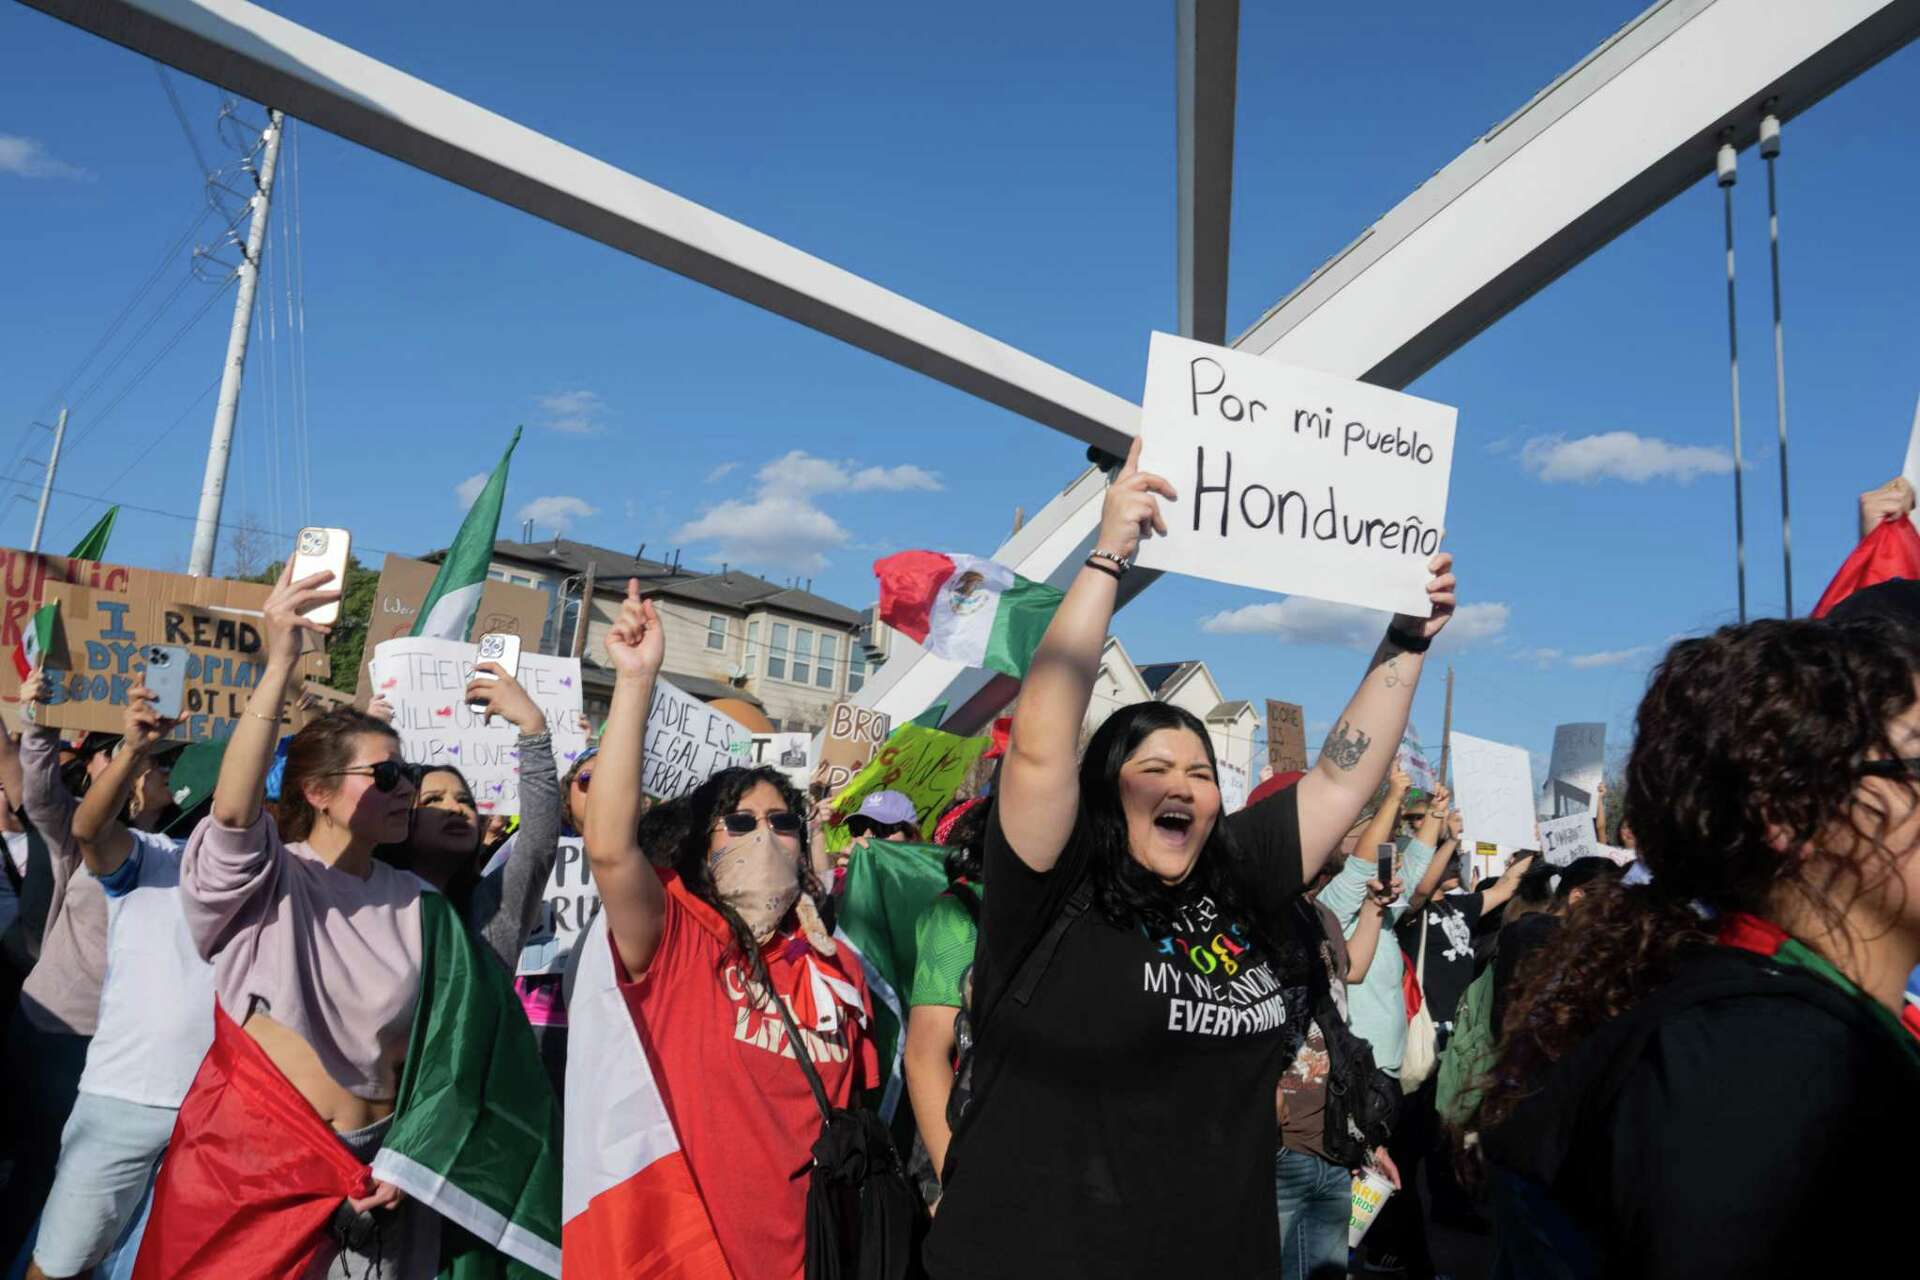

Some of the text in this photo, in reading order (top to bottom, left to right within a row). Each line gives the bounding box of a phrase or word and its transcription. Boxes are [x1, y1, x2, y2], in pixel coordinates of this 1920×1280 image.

[1190, 356, 1434, 465] Por mi pueblo
[1192, 445, 1439, 557] Hondureño
[96, 600, 263, 654] I READ
[40, 667, 134, 706] BOOK
[704, 714, 735, 752] ES
[1143, 961, 1182, 996] MY
[1167, 993, 1287, 1038] EVERYTHING
